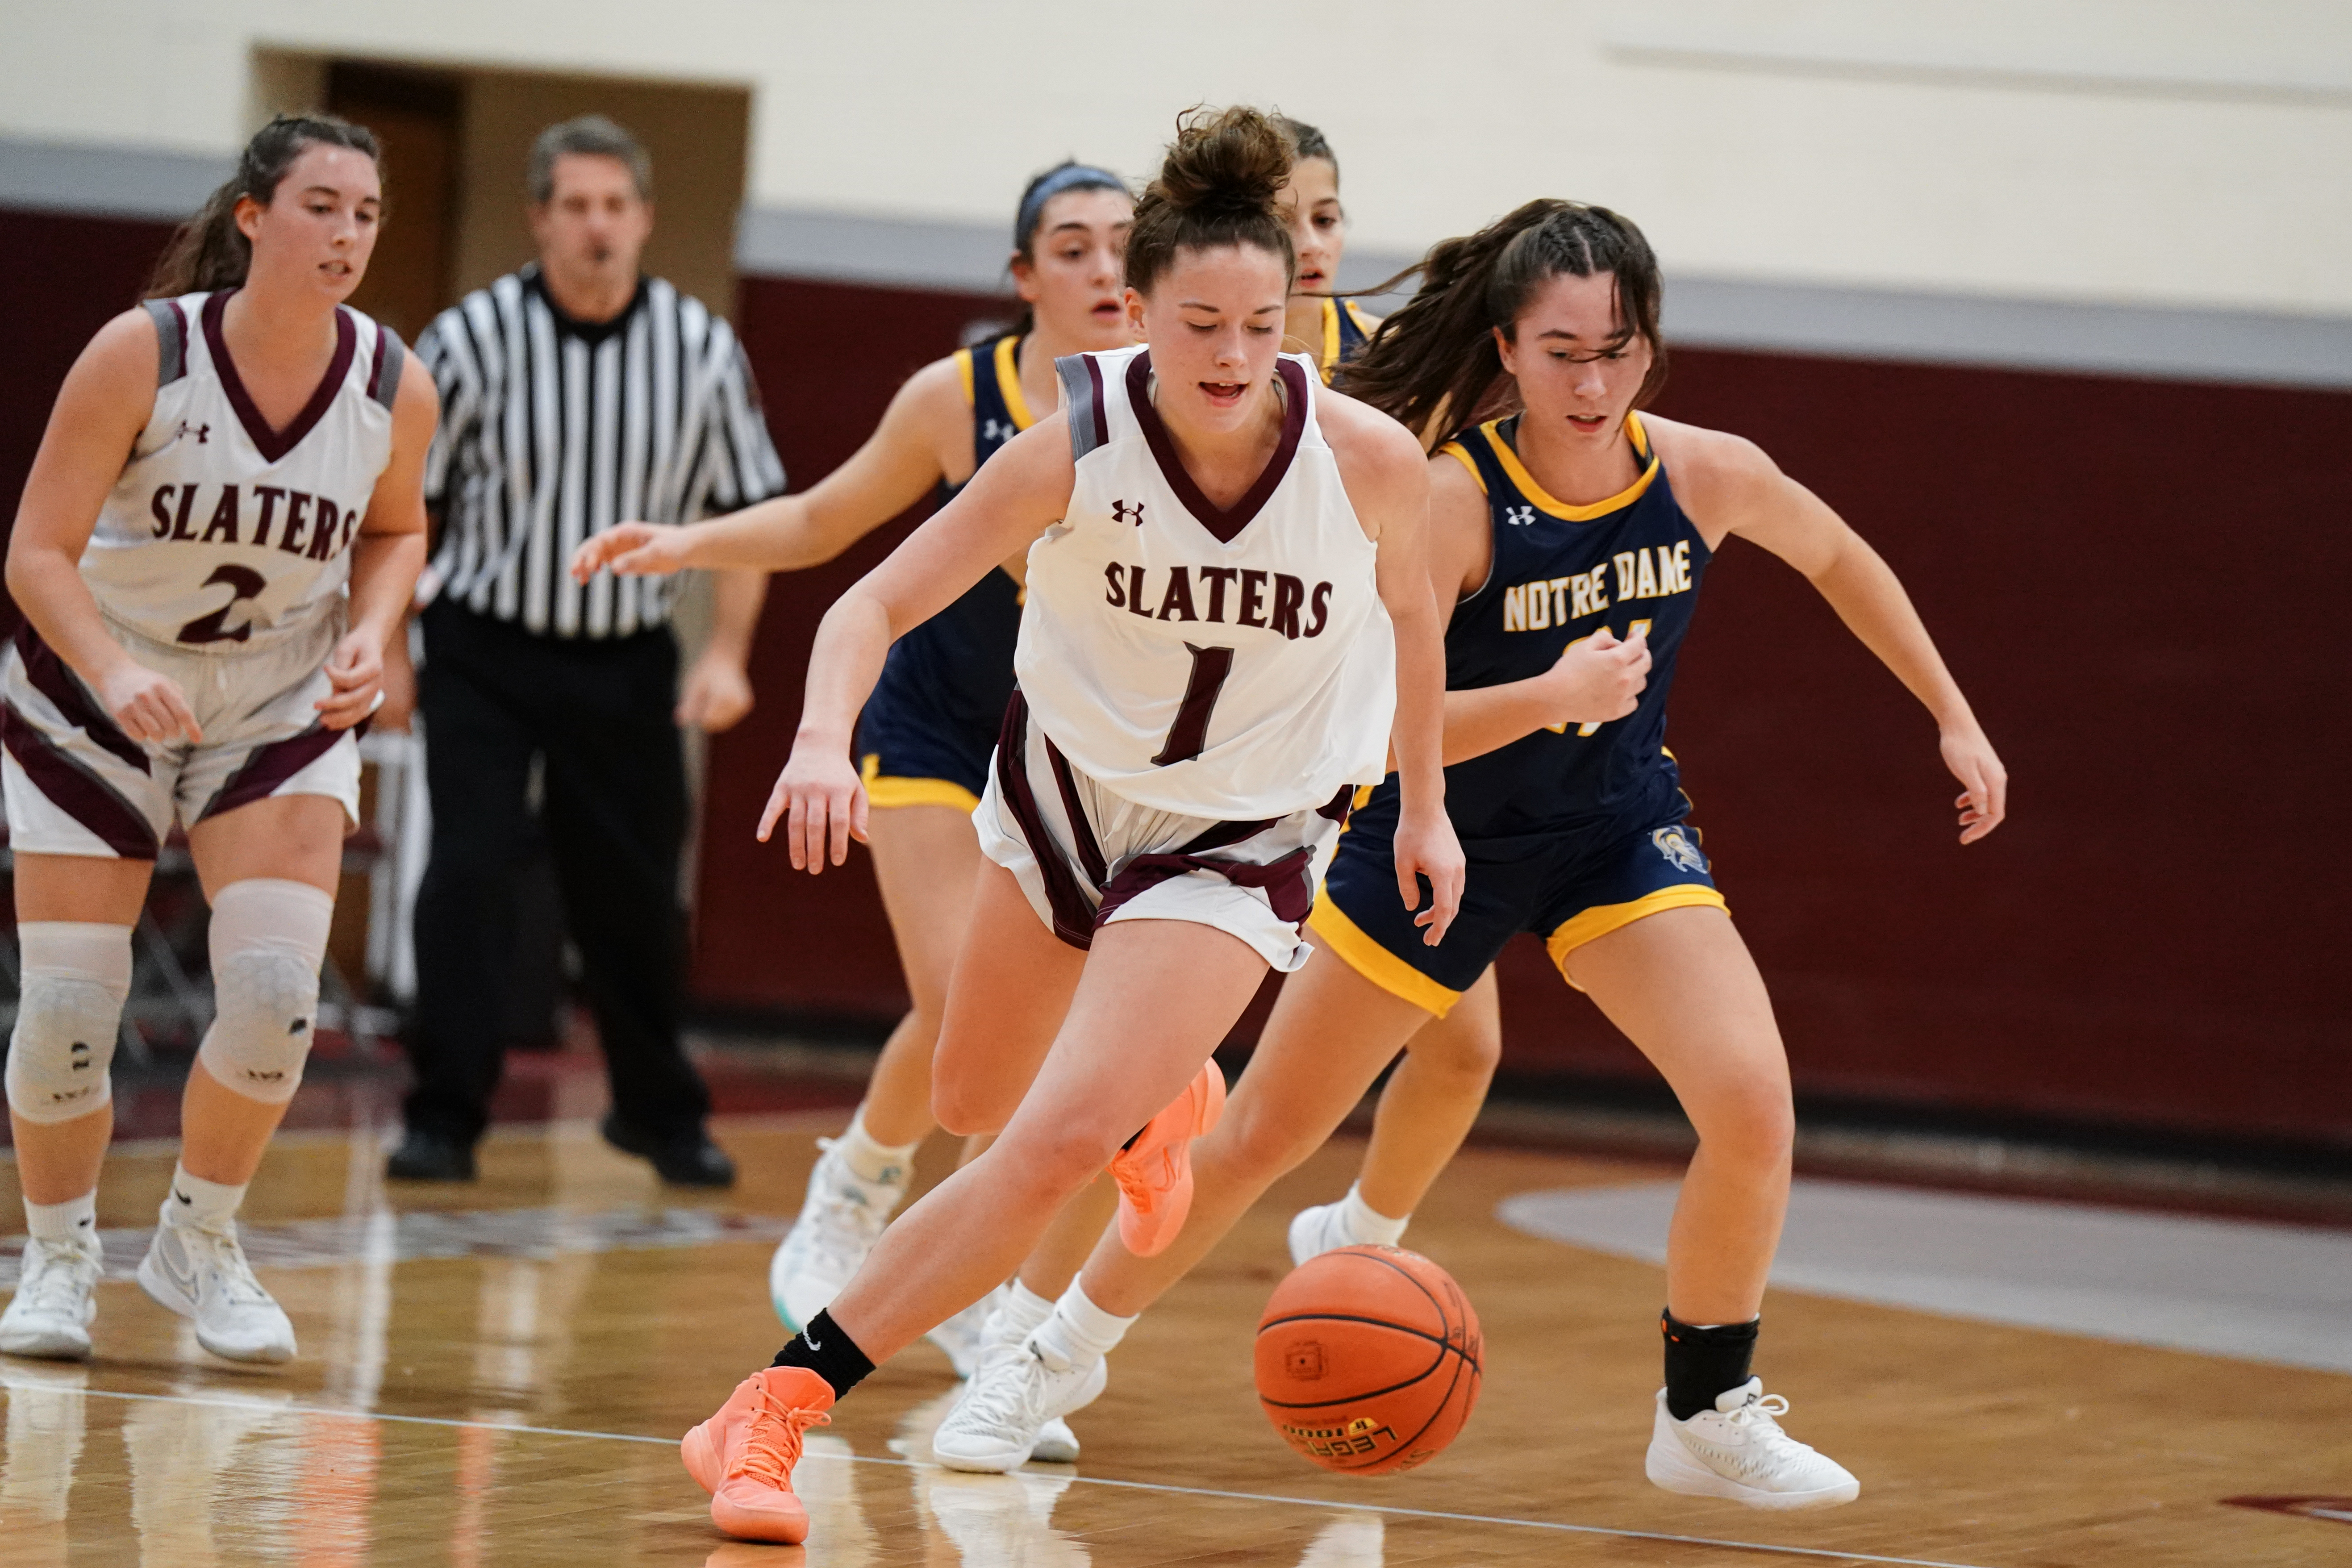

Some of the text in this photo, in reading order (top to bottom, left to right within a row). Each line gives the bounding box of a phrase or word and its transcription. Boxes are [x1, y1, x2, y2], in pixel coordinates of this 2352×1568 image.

[151, 484, 357, 561] SLATERS
[176, 563, 267, 643] 2
[1104, 561, 1333, 640] SLATERS
[1503, 539, 1692, 632] NOTRE DAME
[1150, 641, 1235, 767] 1
